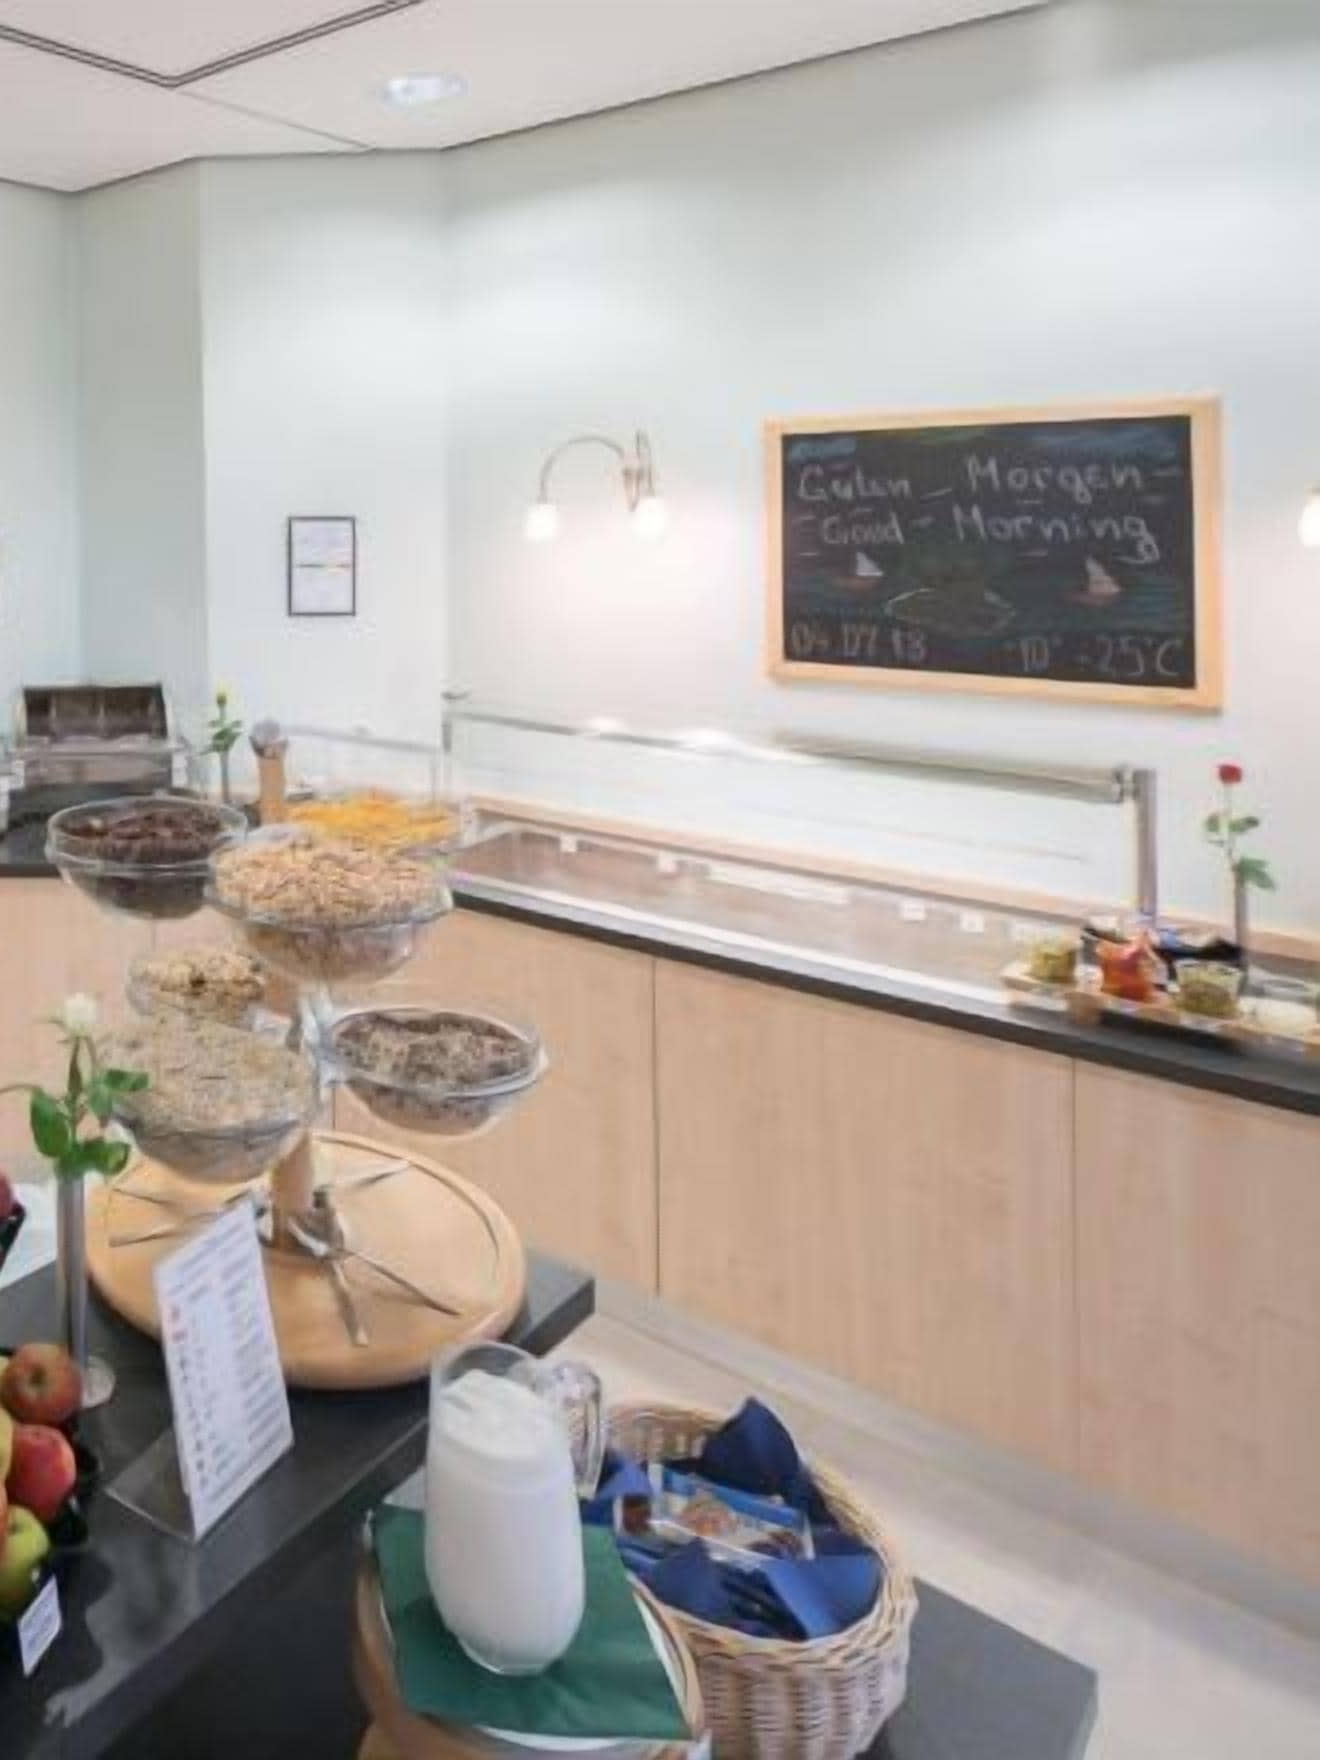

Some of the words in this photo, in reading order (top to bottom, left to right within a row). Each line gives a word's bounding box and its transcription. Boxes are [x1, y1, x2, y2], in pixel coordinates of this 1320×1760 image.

[798, 464, 913, 501] Guten
[966, 454, 1145, 504] Morgen
[952, 503, 1160, 564] Morning
